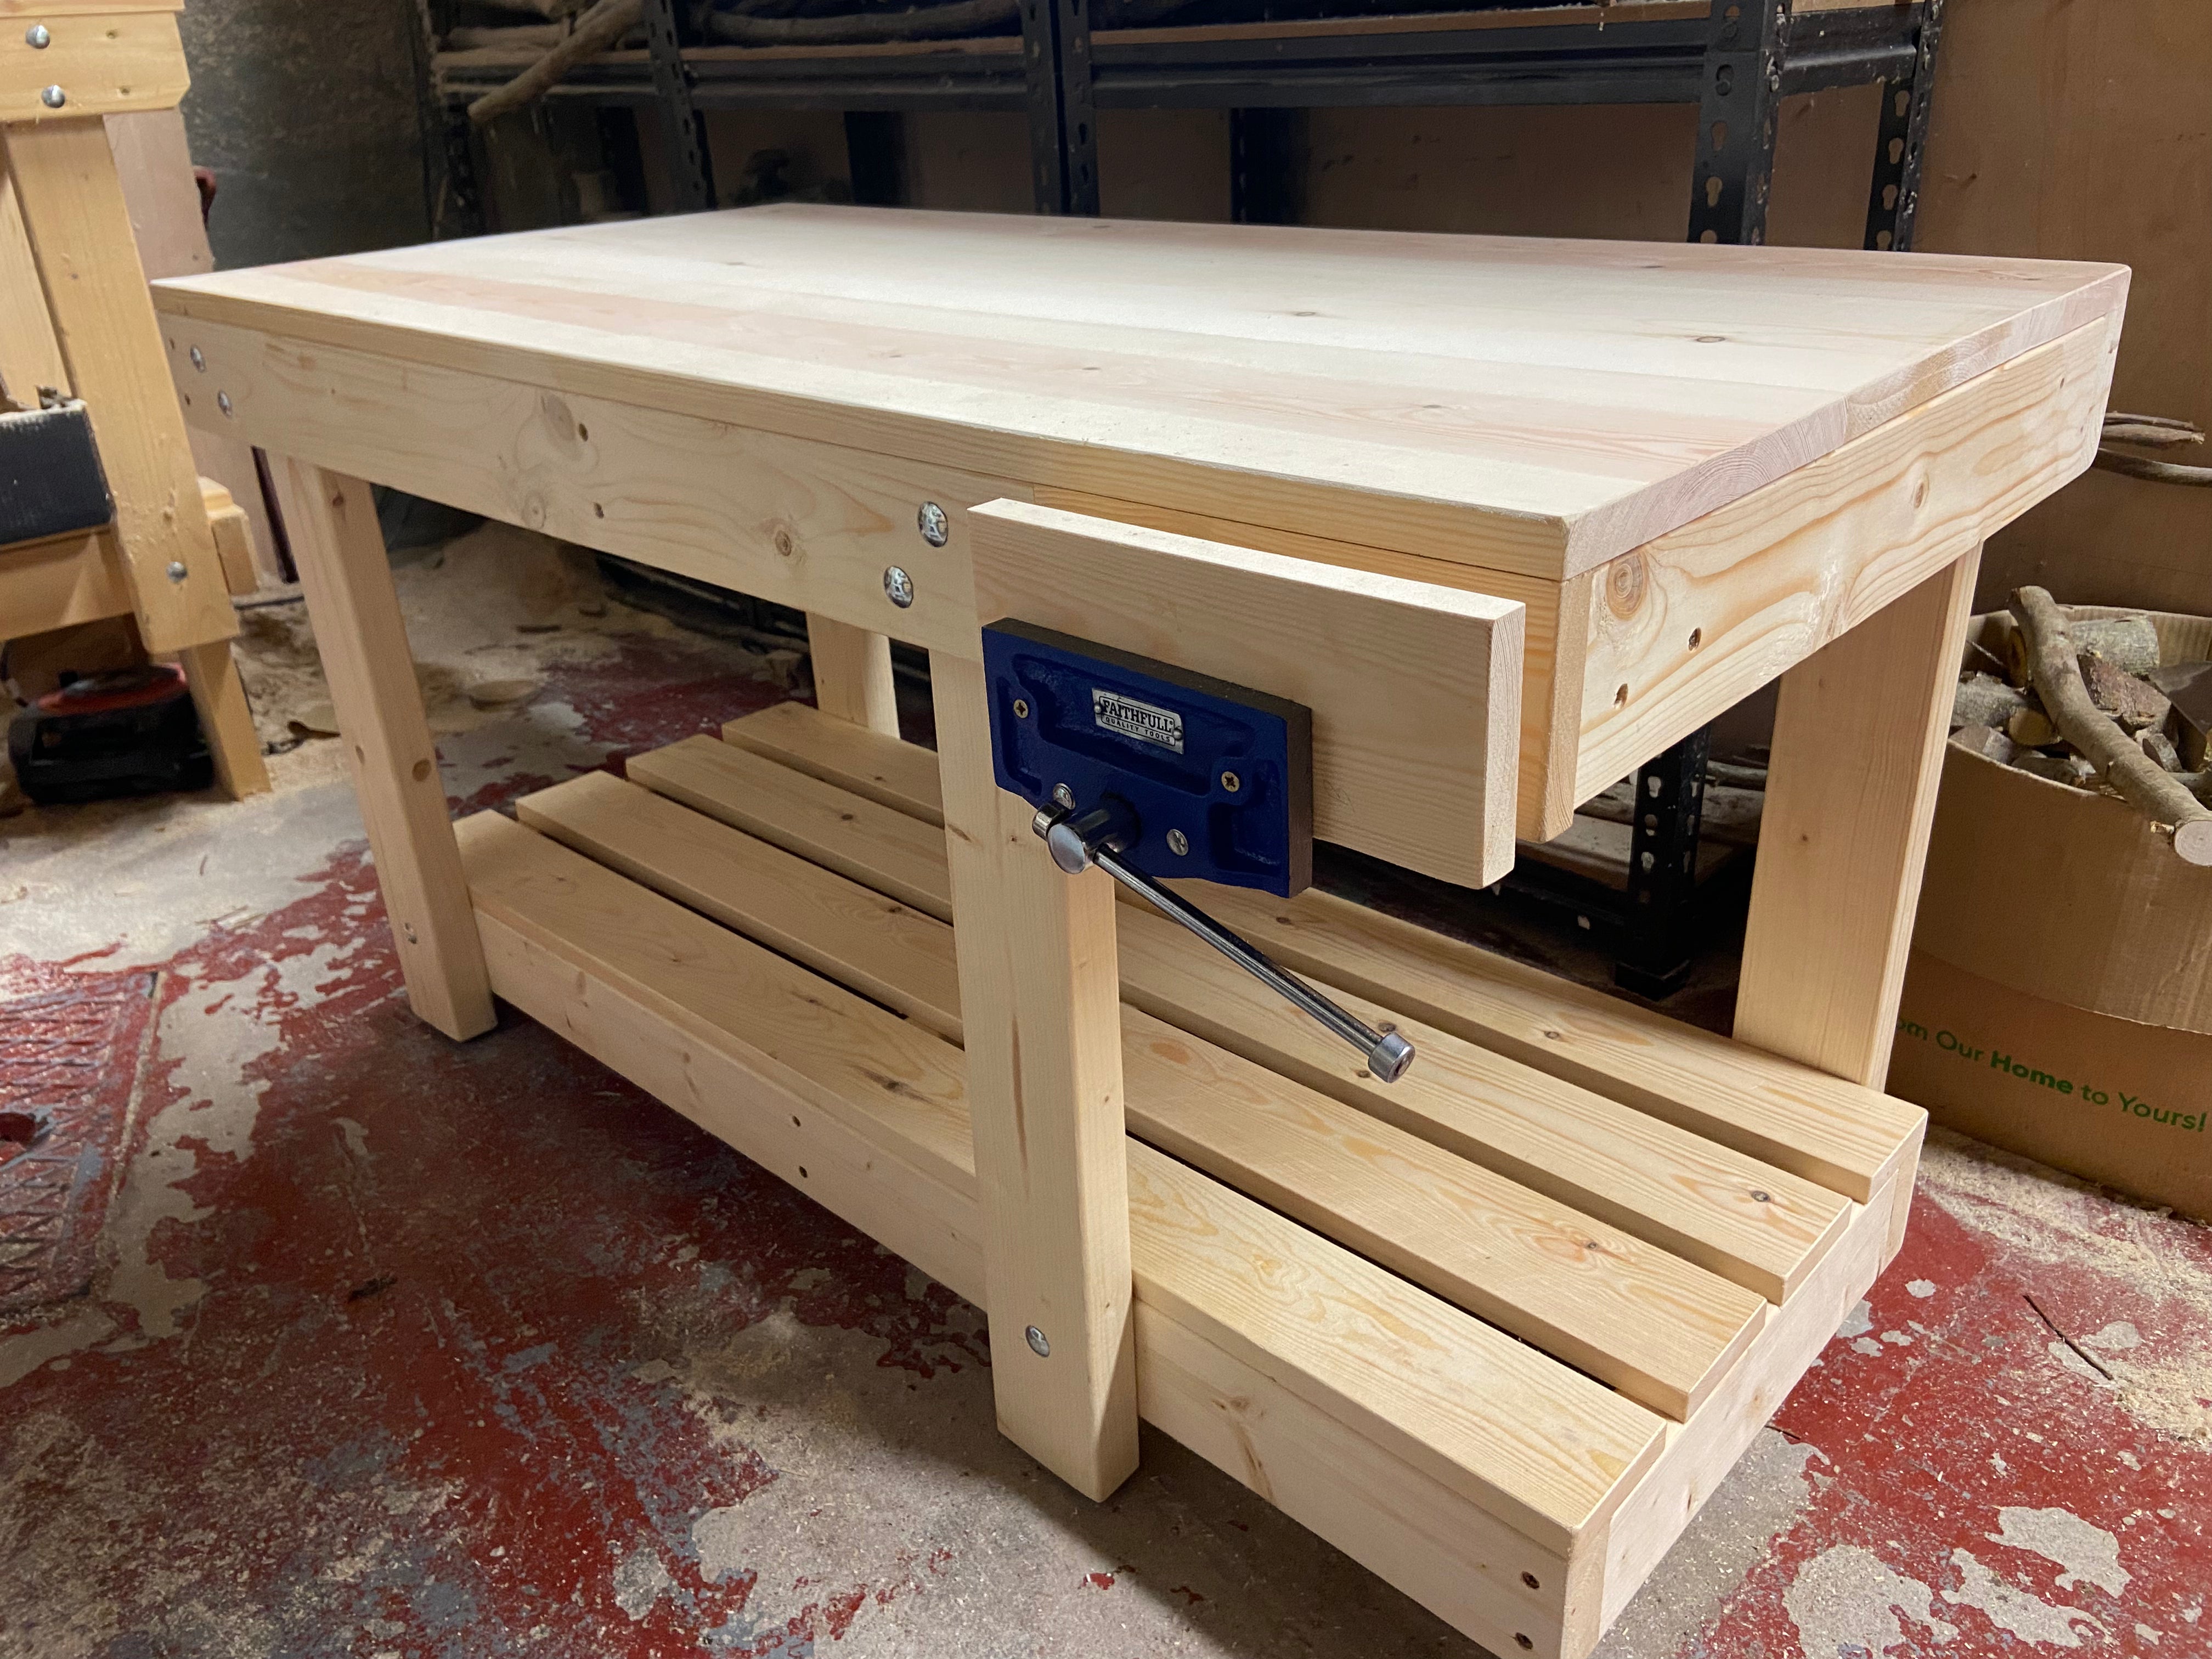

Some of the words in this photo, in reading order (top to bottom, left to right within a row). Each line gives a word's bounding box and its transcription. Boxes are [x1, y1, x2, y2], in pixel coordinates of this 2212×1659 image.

[1105, 716, 1139, 732] QUALITY
[1145, 729, 1170, 742] TOOLS
[1936, 1030, 1984, 1061] Our
[1990, 1050, 2073, 1094] Home
[2081, 1085, 2109, 1105] to
[2118, 1091, 2207, 1132] Yours!
